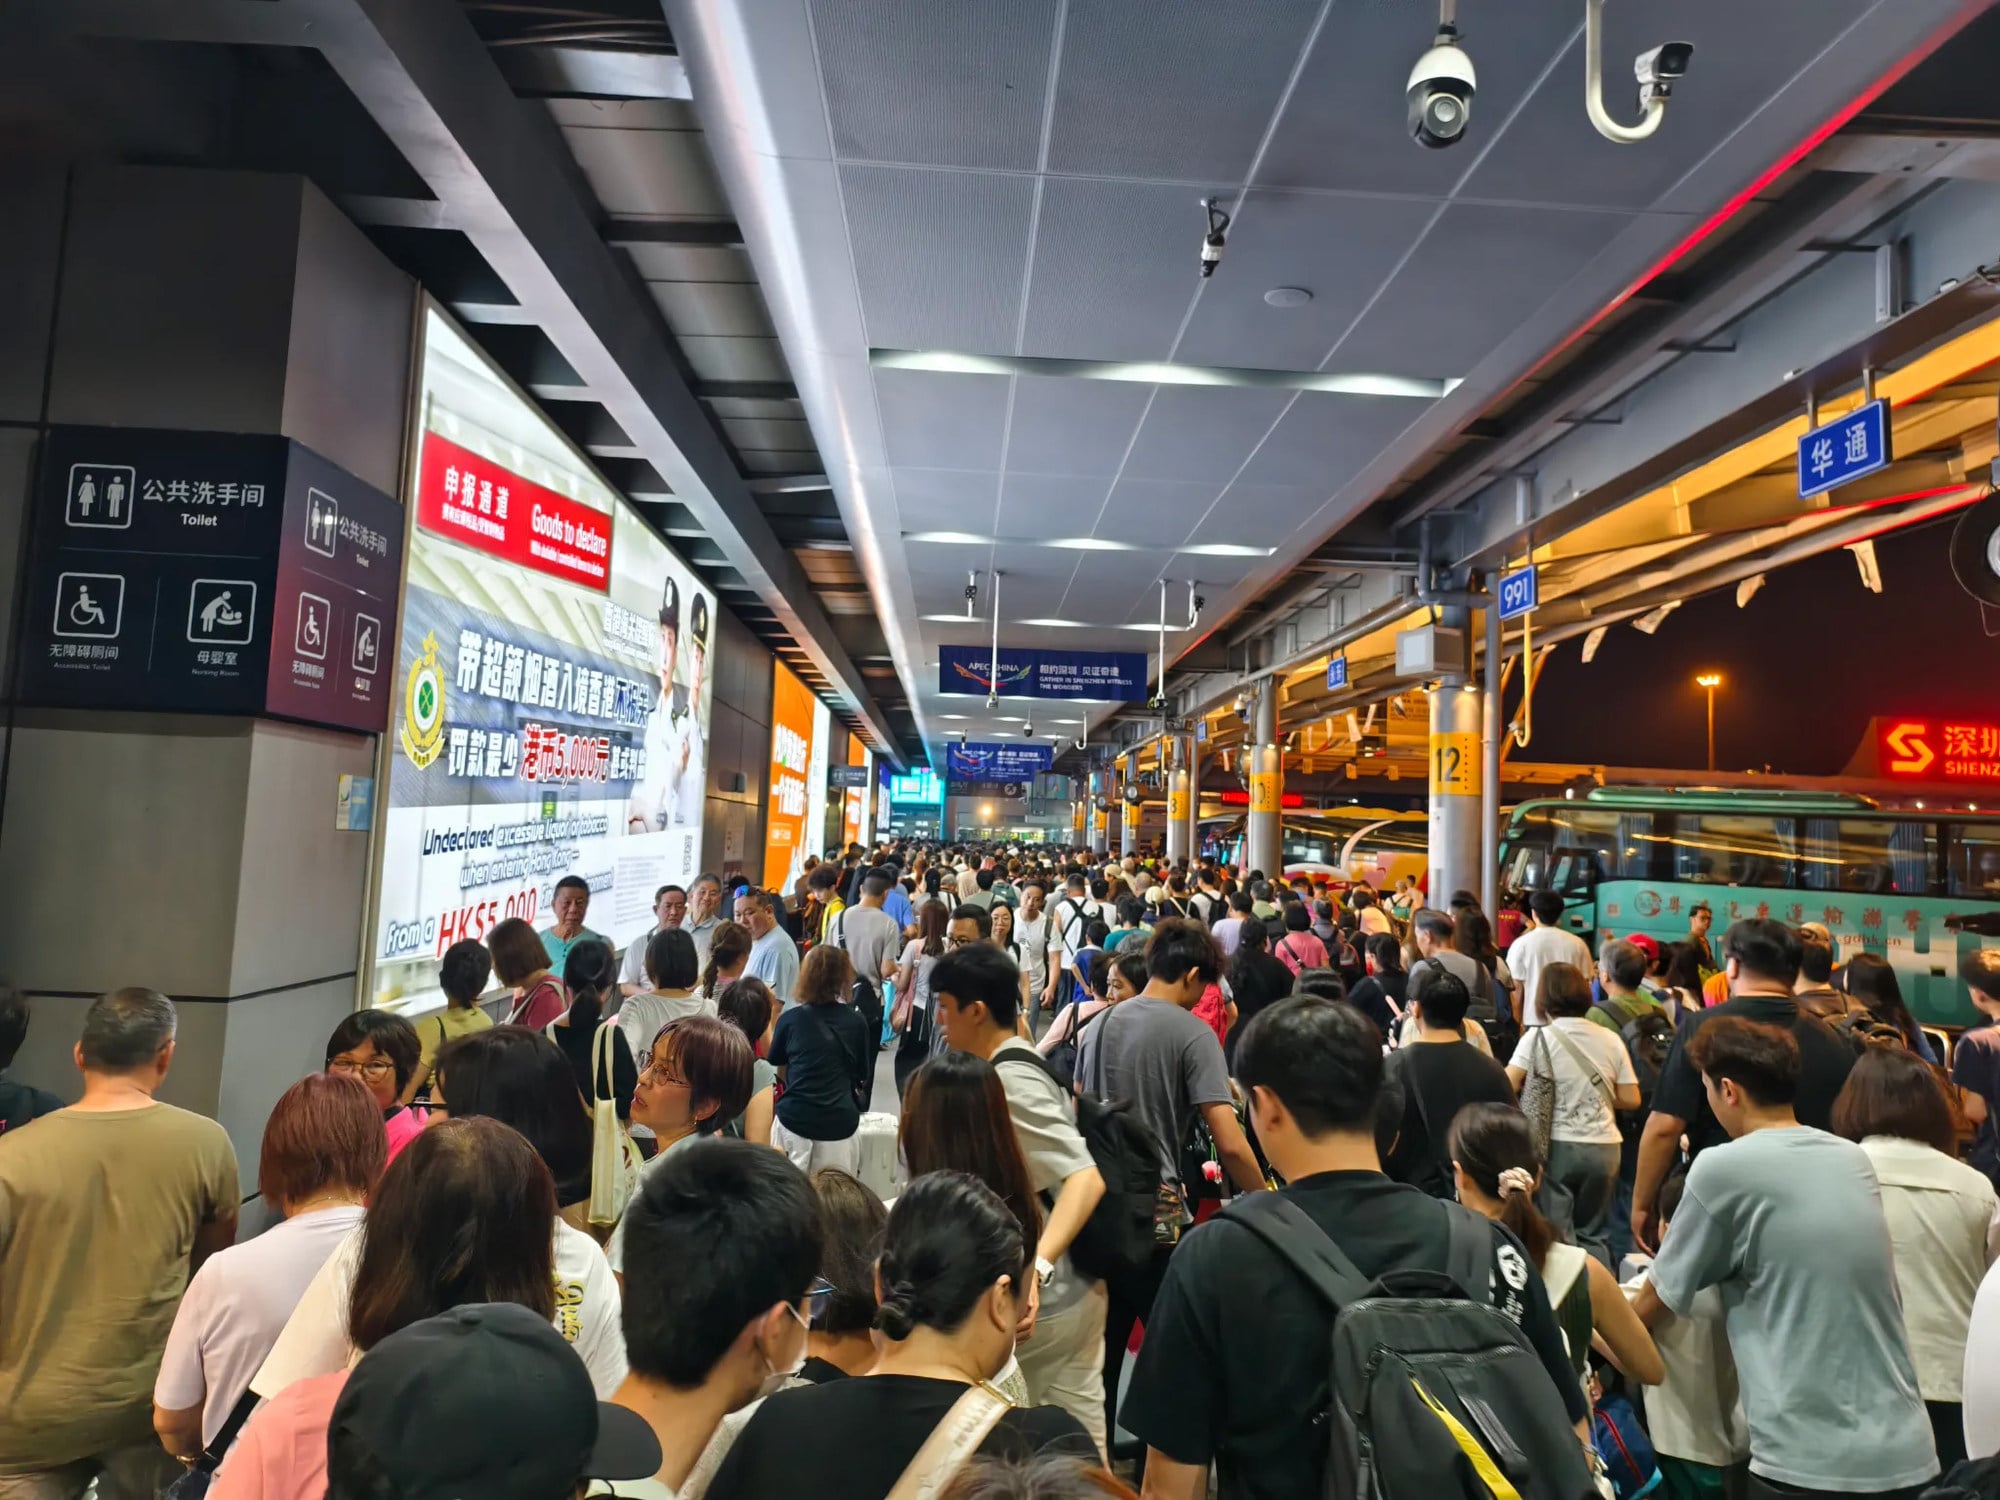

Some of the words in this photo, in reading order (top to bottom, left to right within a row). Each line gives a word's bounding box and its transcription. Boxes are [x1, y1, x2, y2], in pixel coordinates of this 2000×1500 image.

[1811, 421, 1868, 478] 华通
[142, 478, 265, 508] 公共洗手间
[444, 464, 510, 520] 申报通道
[180, 512, 218, 527] Toilet
[339, 514, 388, 557] 公共洗手间
[531, 503, 563, 542] Goods
[564, 519, 575, 546] to
[575, 522, 607, 558] declare
[1504, 577, 1528, 609] 991
[197, 650, 238, 666] 母婴室
[968, 661, 990, 671] APEC
[1436, 747, 1461, 783] 12
[422, 824, 496, 856] Undeclared
[496, 821, 545, 849] excessive
[459, 859, 490, 890] when
[490, 853, 529, 883] entering
[385, 921, 421, 956] from
[423, 918, 436, 942] a
